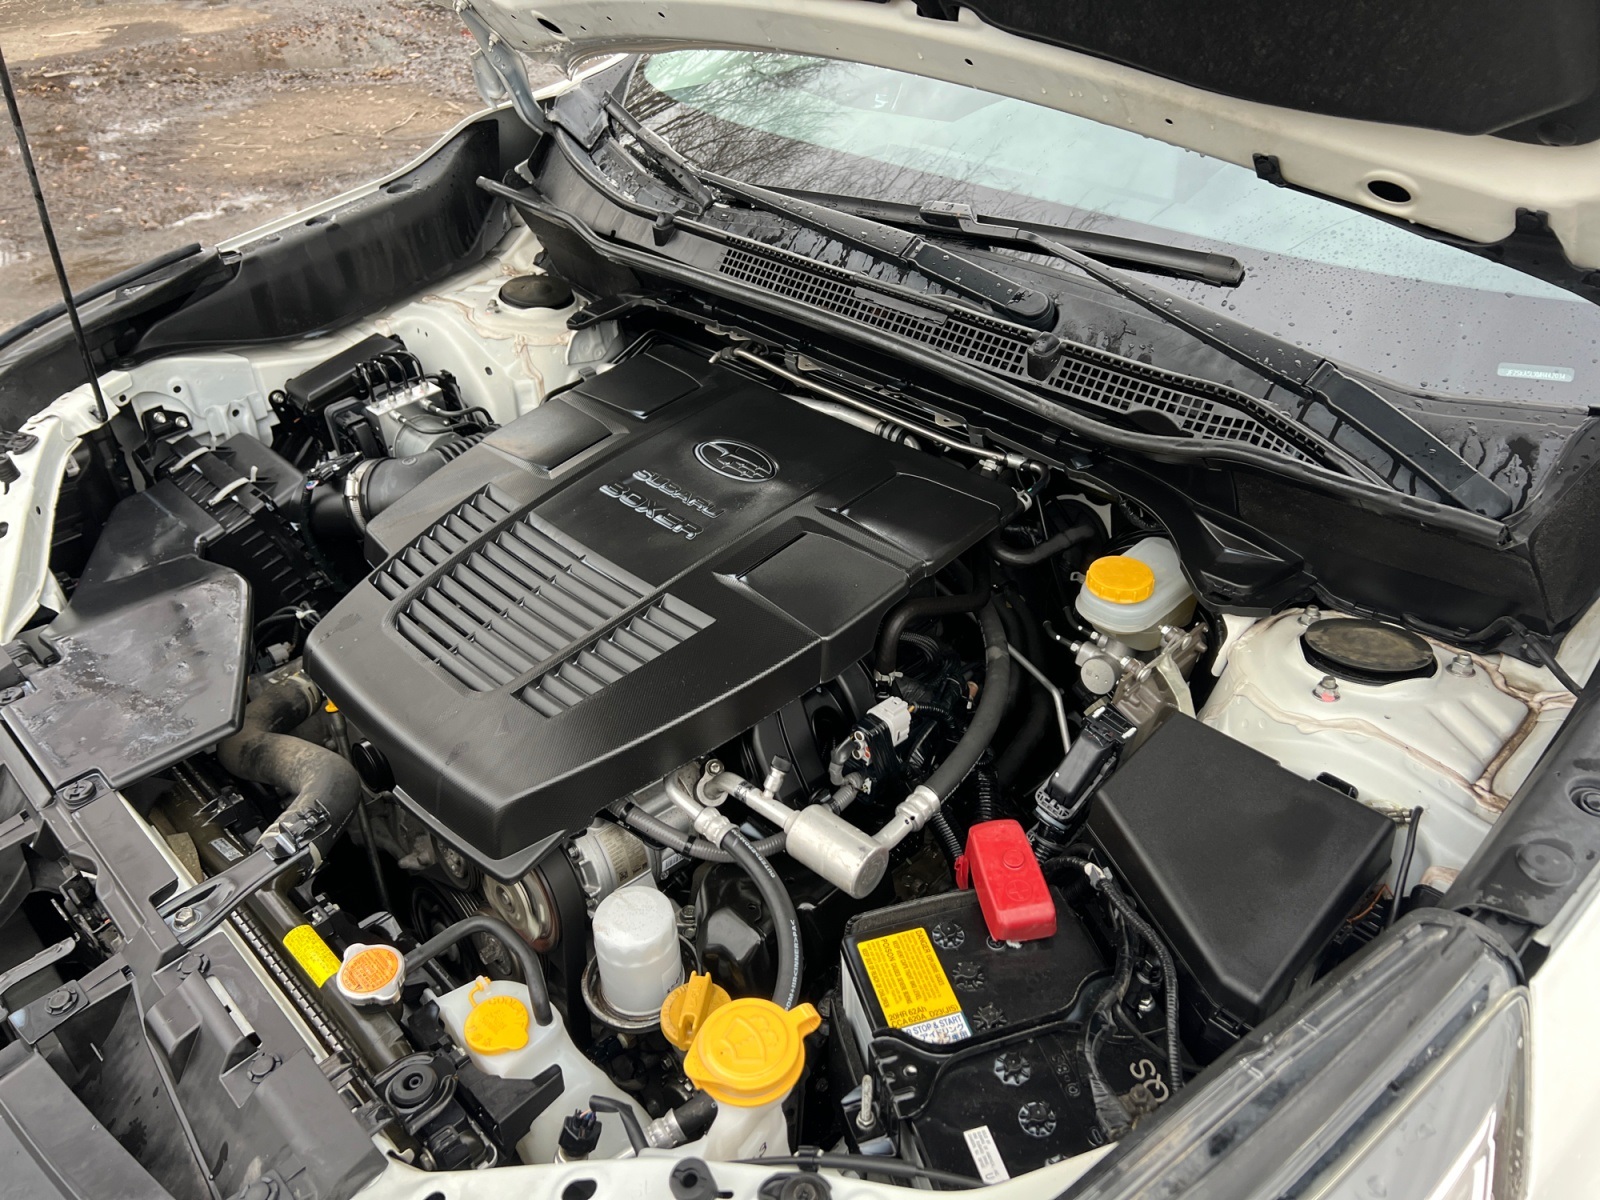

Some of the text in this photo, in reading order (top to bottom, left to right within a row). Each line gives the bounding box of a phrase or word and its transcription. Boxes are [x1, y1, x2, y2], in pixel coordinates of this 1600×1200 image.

[632, 469, 725, 518] SUBARU
[599, 481, 703, 540] BOXER
[880, 939, 895, 960] POISON
[915, 930, 930, 952] DANGER
[888, 1006, 927, 1021] 20HR 62Ah
[891, 1018, 908, 1028] CCA
[908, 1014, 926, 1023] 620A
[912, 1022, 932, 1036] STOP
[940, 1014, 962, 1027] START
